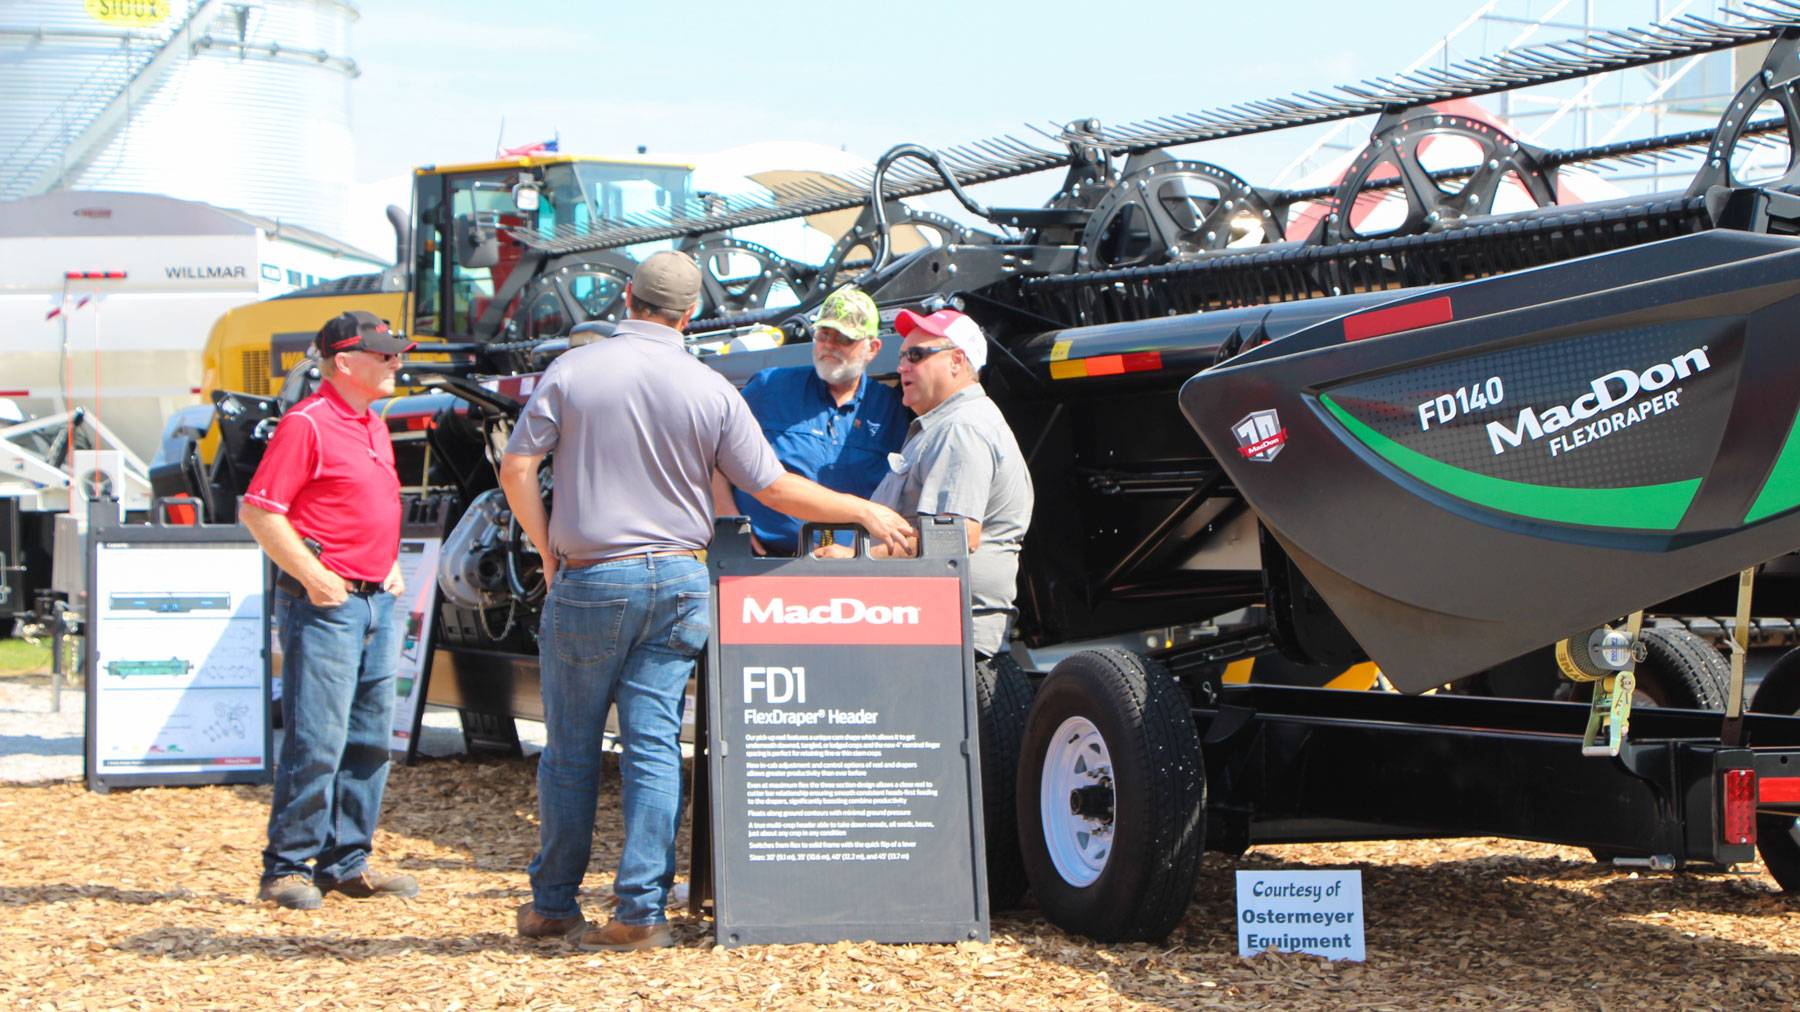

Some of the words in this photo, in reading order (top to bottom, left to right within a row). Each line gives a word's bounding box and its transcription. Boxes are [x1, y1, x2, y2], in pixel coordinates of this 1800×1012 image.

[165, 266, 246, 279] WILLMAR
[1417, 376, 1504, 432] FD140
[1486, 345, 1711, 455] MacDon
[1549, 390, 1681, 457] FLEXDRAPER
[1248, 438, 1280, 454] MacDon
[742, 598, 920, 625] MacDon
[743, 666, 806, 704] FD1
[828, 708, 878, 725] Header
[1252, 880, 1322, 902] Courtesy
[1326, 880, 1342, 898] of
[1242, 909, 1354, 926] Ostermeyer
[1247, 934, 1352, 951] Equipment
